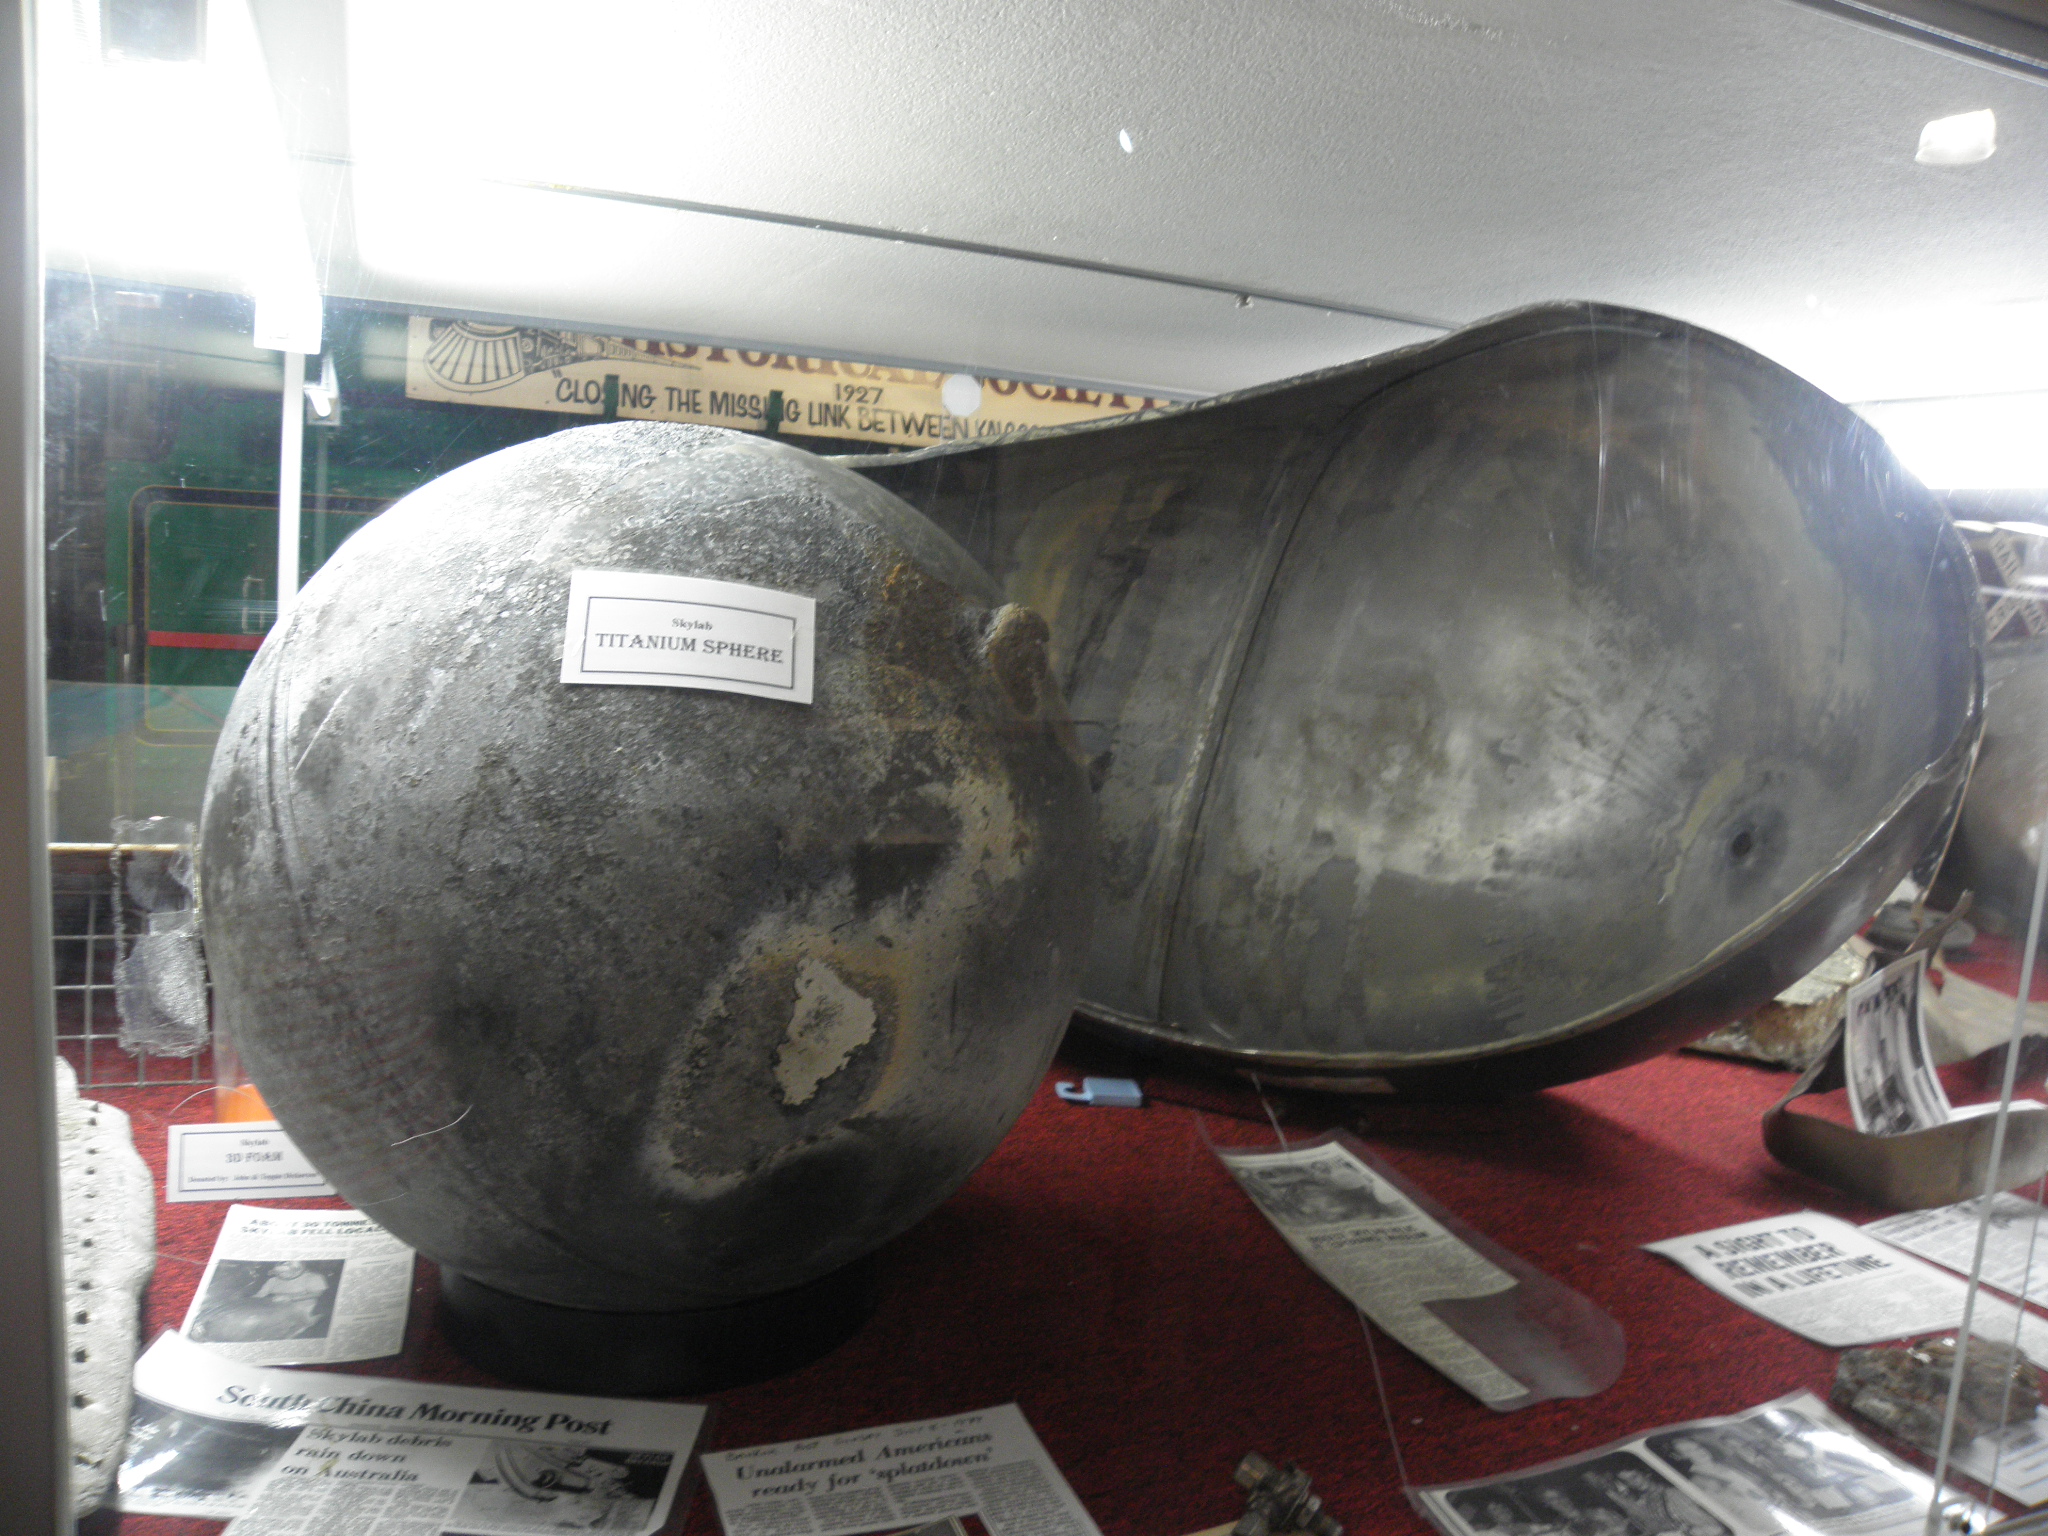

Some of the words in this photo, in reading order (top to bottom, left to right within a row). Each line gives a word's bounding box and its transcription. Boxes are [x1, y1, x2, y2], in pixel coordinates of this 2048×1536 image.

[834, 383, 884, 405] 1927
[665, 386, 703, 414] THE
[808, 402, 851, 429] LINK
[857, 406, 969, 440] BETWEEN
[671, 617, 713, 632] Skylab
[595, 632, 697, 652] TITANIUM
[703, 638, 784, 664] SPHERE
[1694, 1243, 1721, 1259] A
[1713, 1231, 1785, 1256] SIGHT
[1775, 1225, 1816, 1244] TO
[1714, 1241, 1848, 1281] REMEMBER
[1731, 1278, 1774, 1299] IN
[1765, 1275, 1795, 1293] A
[318, 1396, 406, 1420] China
[408, 1402, 544, 1433] Morning
[543, 1413, 613, 1436] Post
[306, 1426, 382, 1446] Skylab
[386, 1432, 453, 1448] debris
[294, 1447, 341, 1459] rain
[348, 1449, 407, 1463] down
[736, 1449, 866, 1480] Unalarmed
[874, 1431, 993, 1460] Americans
[280, 1465, 310, 1476] on
[312, 1464, 419, 1482] Australia
[752, 1477, 819, 1499] ready
[827, 1472, 861, 1492] for
